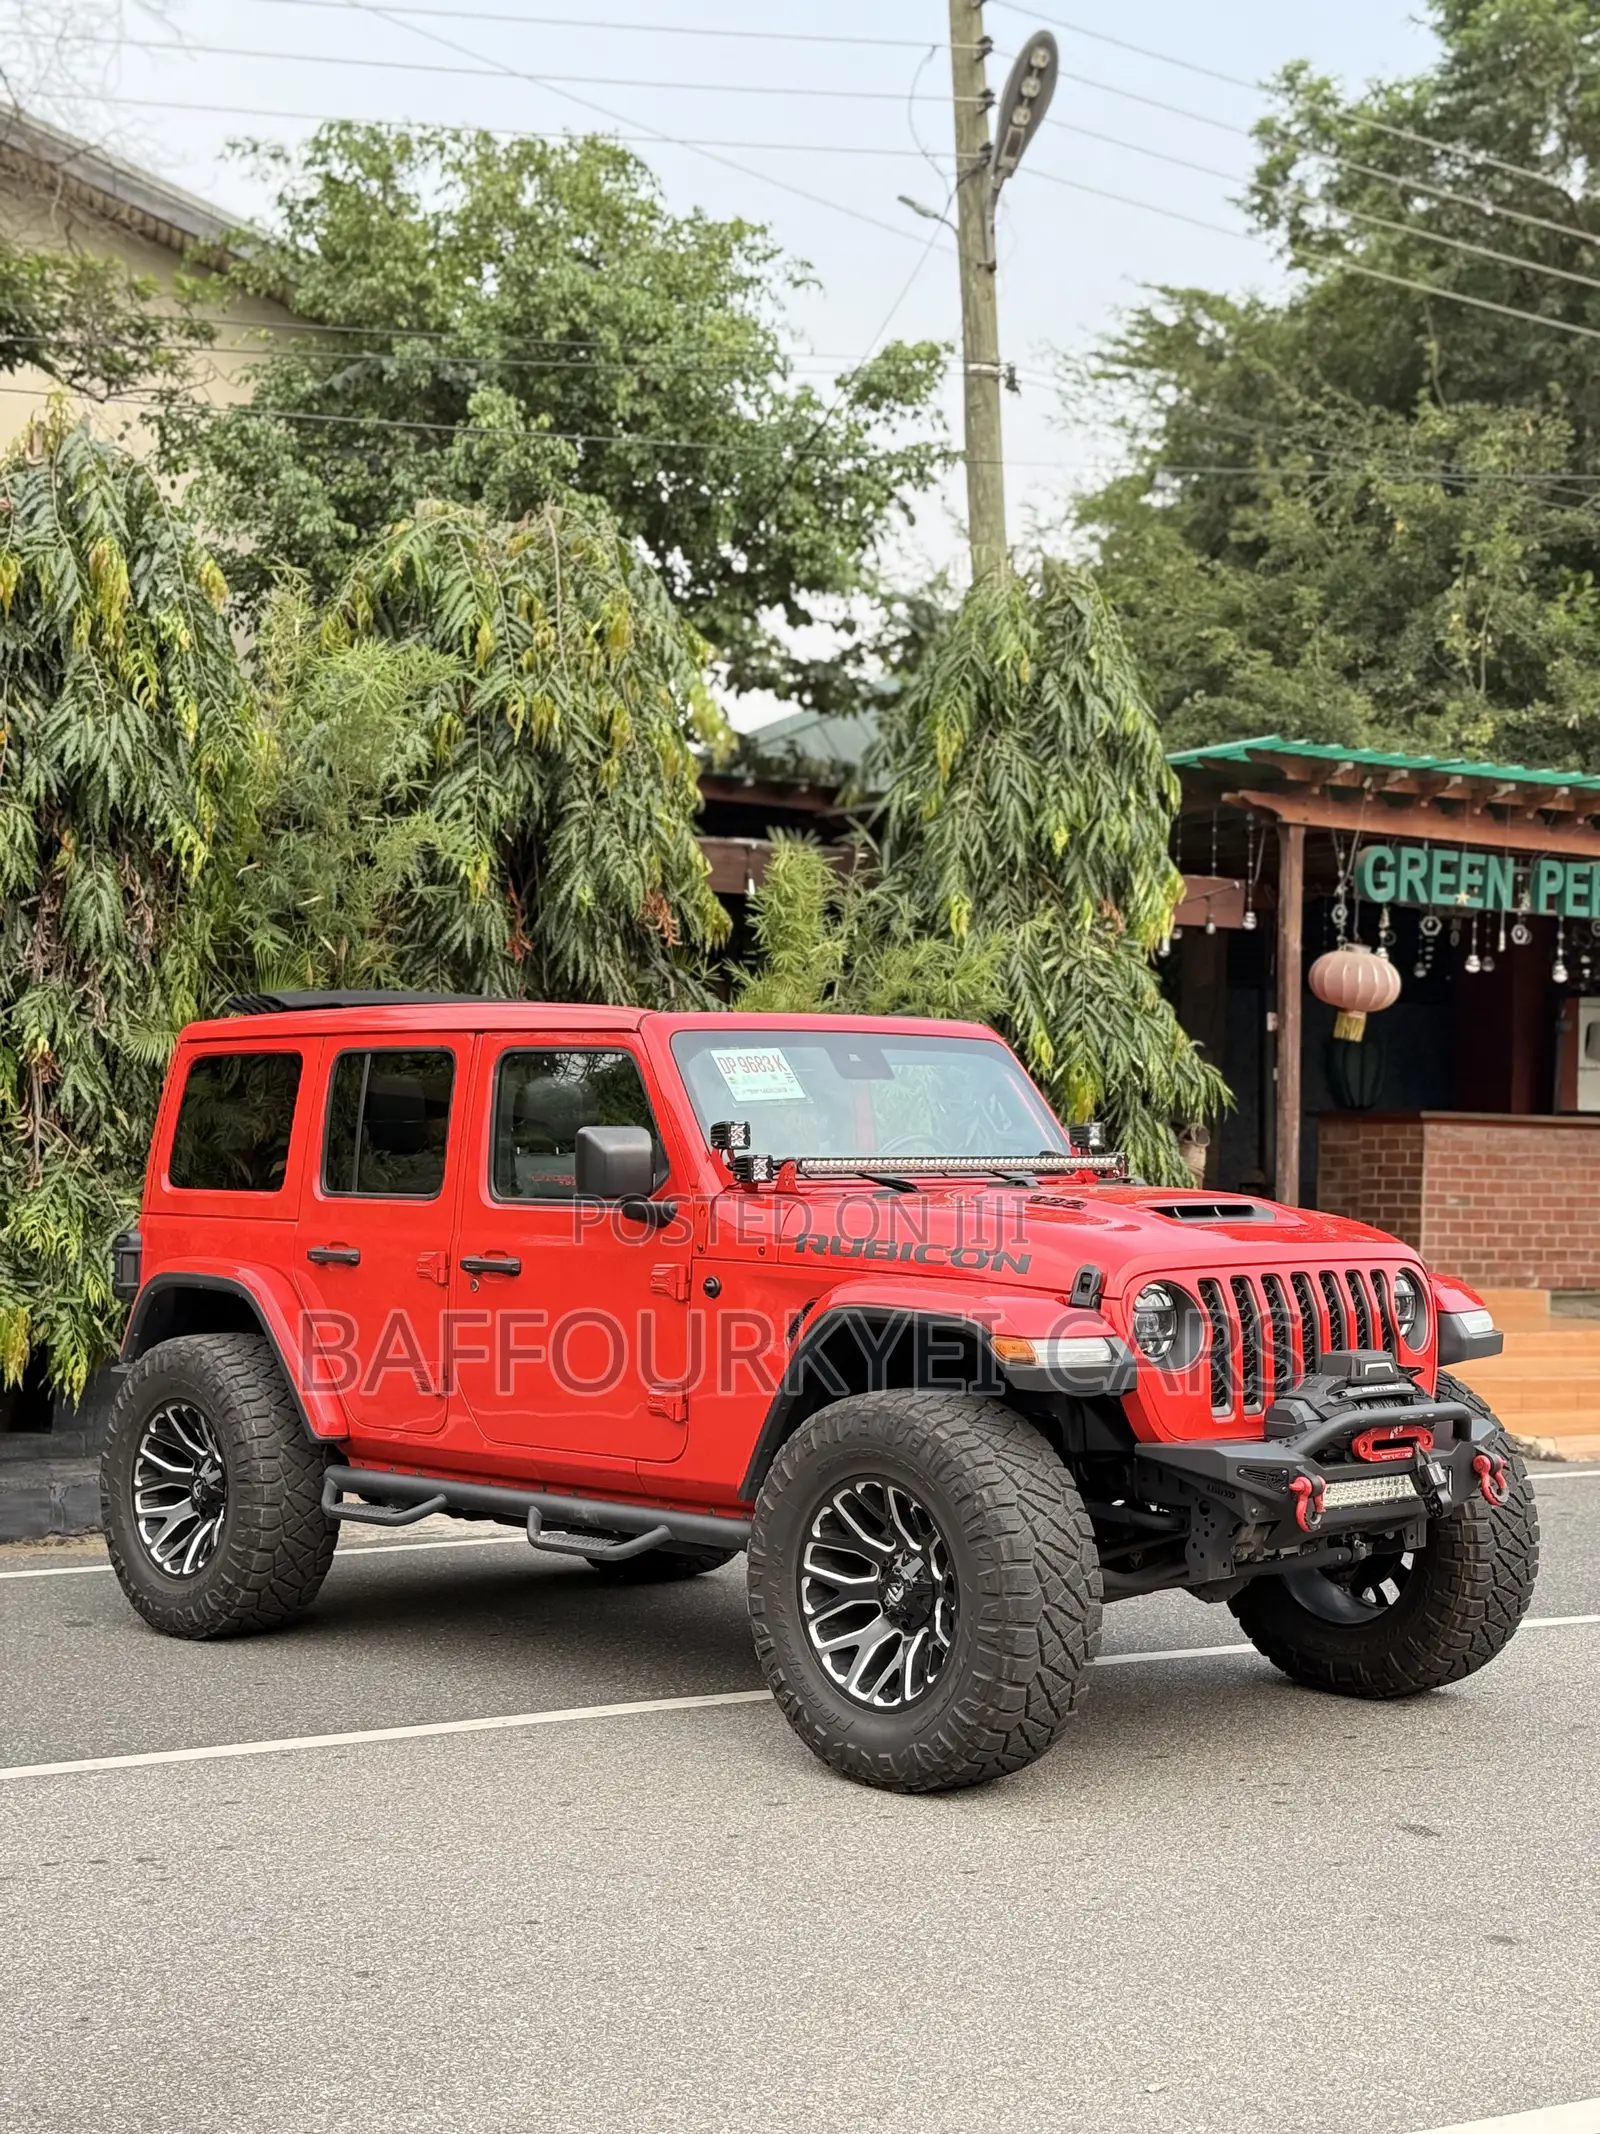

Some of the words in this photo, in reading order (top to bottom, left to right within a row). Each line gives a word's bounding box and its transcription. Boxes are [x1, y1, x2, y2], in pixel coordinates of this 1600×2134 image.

[1363, 844, 1515, 912] GREEN
[716, 1056, 737, 1075] DP
[736, 1055, 776, 1074] 9683
[772, 1054, 788, 1072] K
[794, 1232, 1033, 1275] RUBICON
